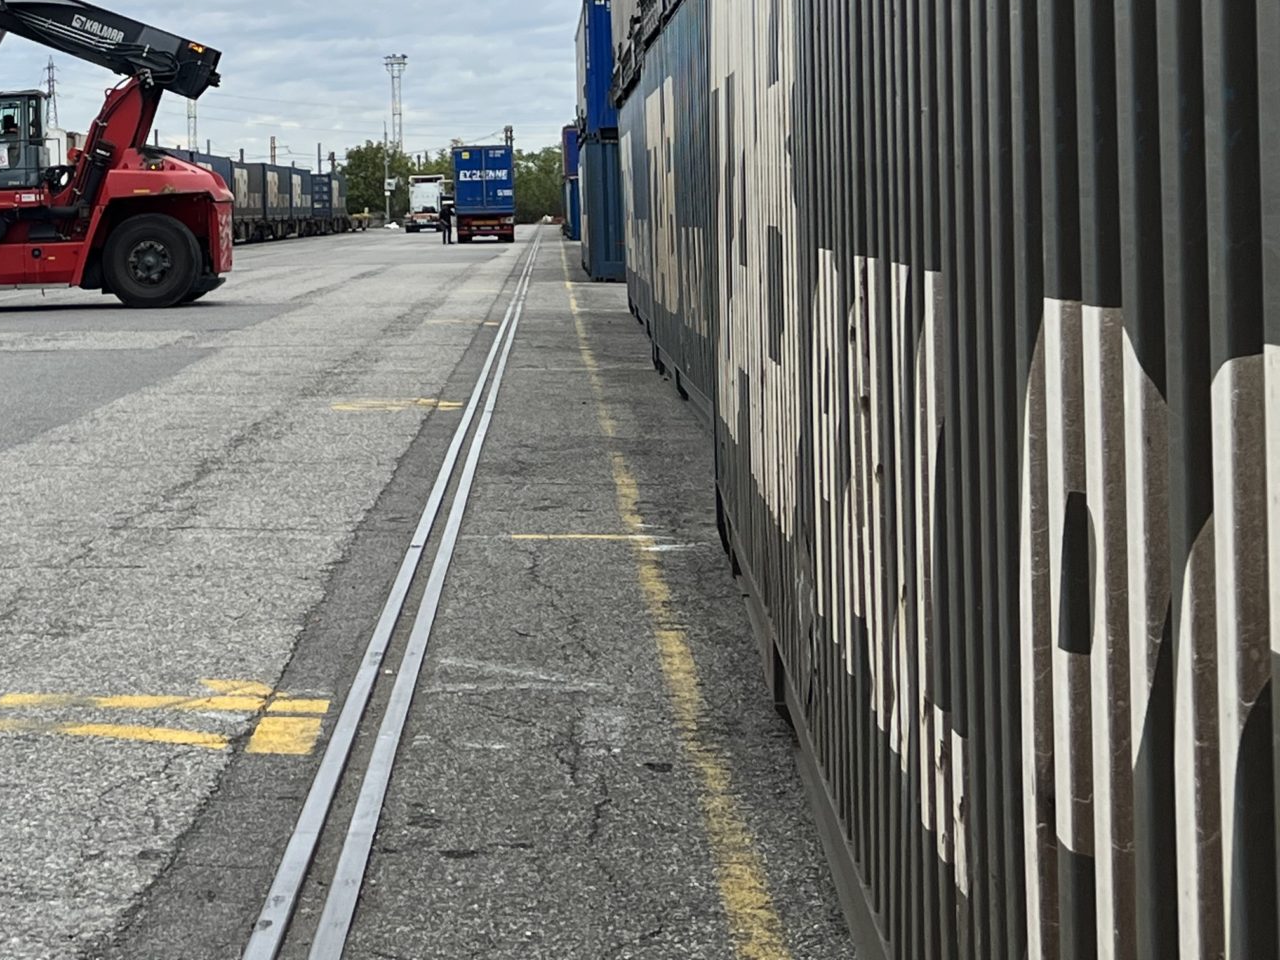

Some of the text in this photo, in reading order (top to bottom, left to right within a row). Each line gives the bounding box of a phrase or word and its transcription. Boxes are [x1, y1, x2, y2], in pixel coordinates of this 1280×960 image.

[84, 19, 125, 43] KALMAR
[645, 75, 680, 315] TAB
[812, 246, 970, 896] RAIL
